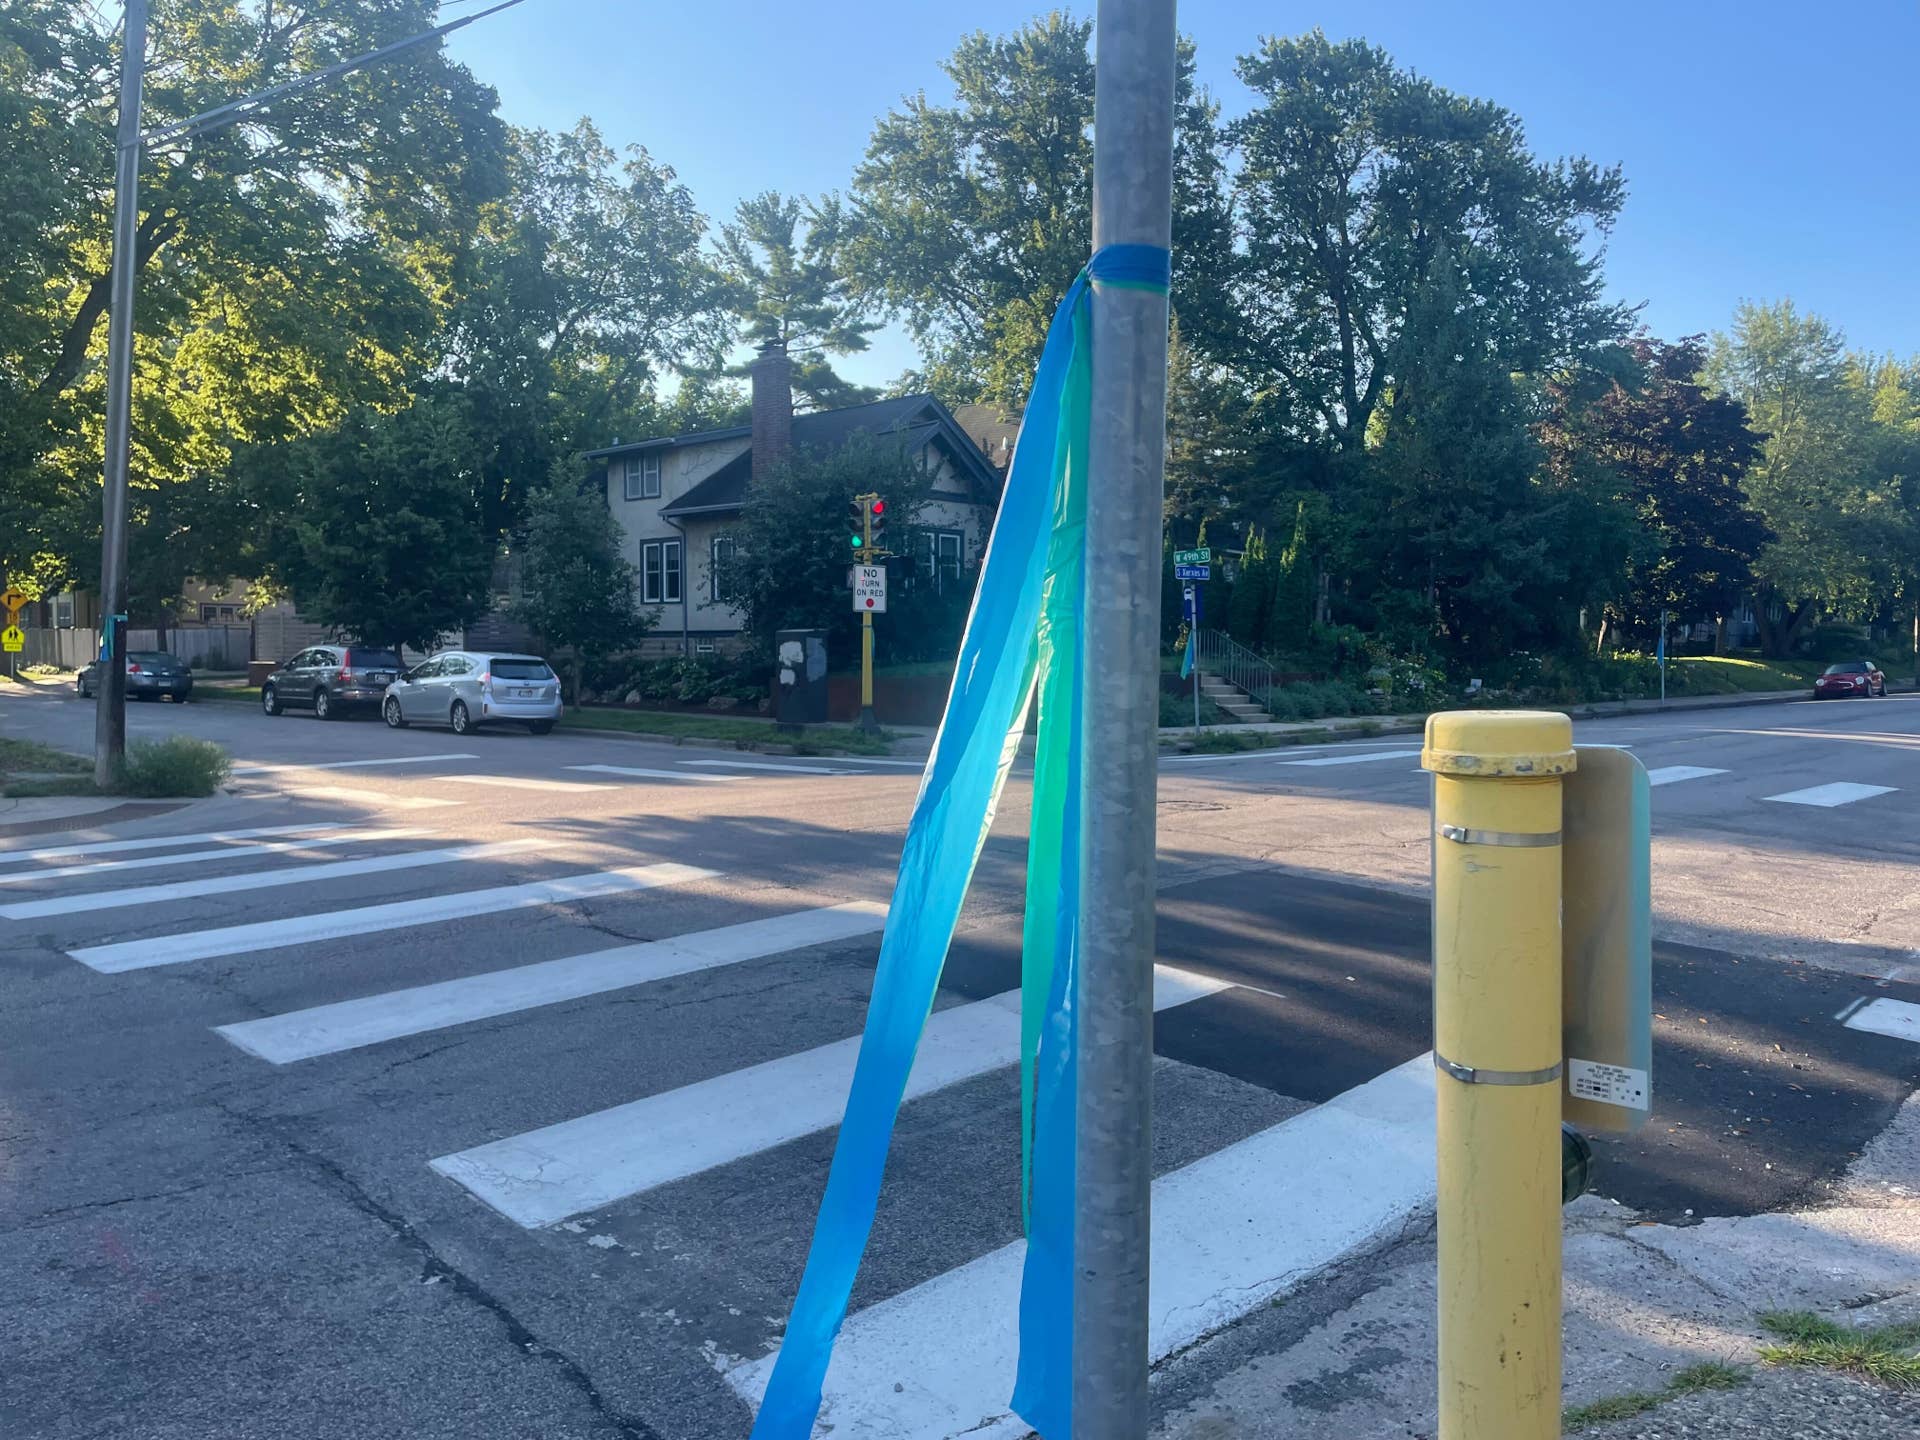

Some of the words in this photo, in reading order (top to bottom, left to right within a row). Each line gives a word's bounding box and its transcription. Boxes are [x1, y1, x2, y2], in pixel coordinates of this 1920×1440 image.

[1183, 551, 1199, 561] 49th
[1200, 550, 1209, 560] St
[863, 568, 878, 578] NO
[859, 579, 880, 588] TURN
[869, 589, 884, 597] RED
